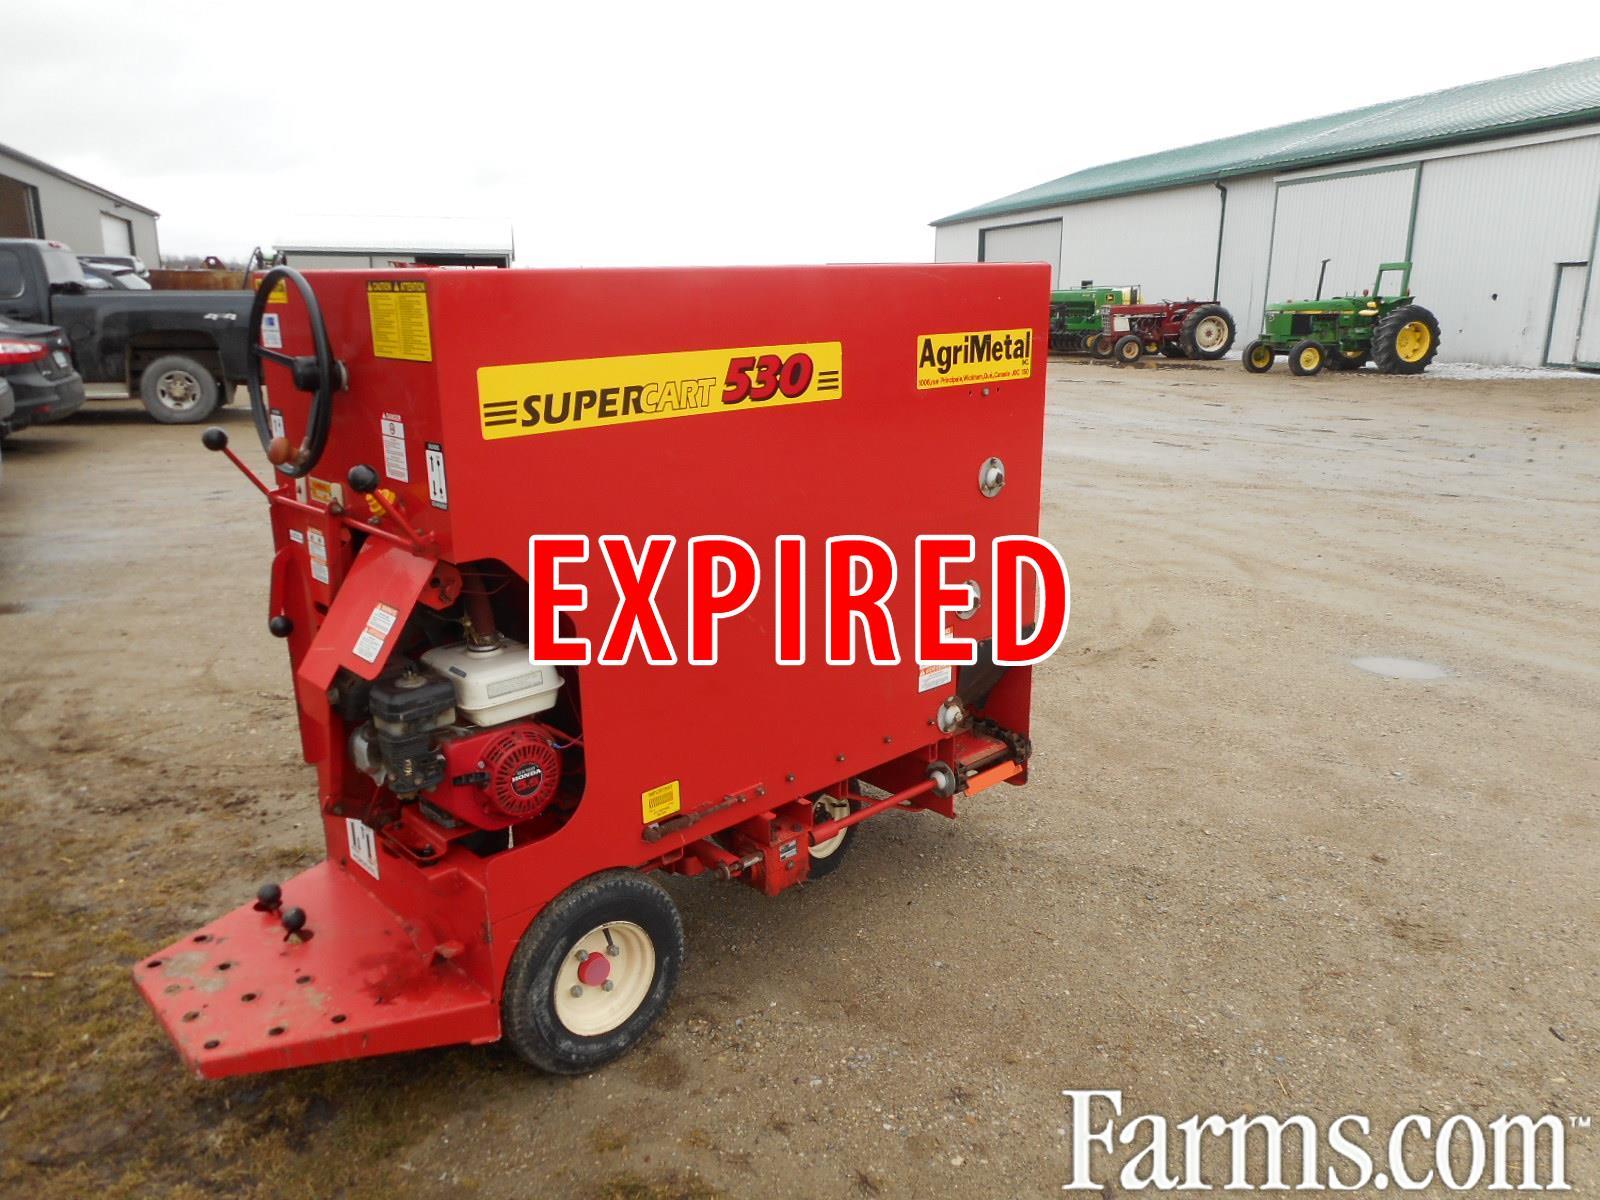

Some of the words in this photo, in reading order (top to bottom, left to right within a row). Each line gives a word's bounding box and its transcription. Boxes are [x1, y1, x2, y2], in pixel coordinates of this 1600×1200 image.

[919, 331, 1031, 374] AgriMetal
[721, 352, 814, 405] 530
[511, 768, 542, 783] HONDA
